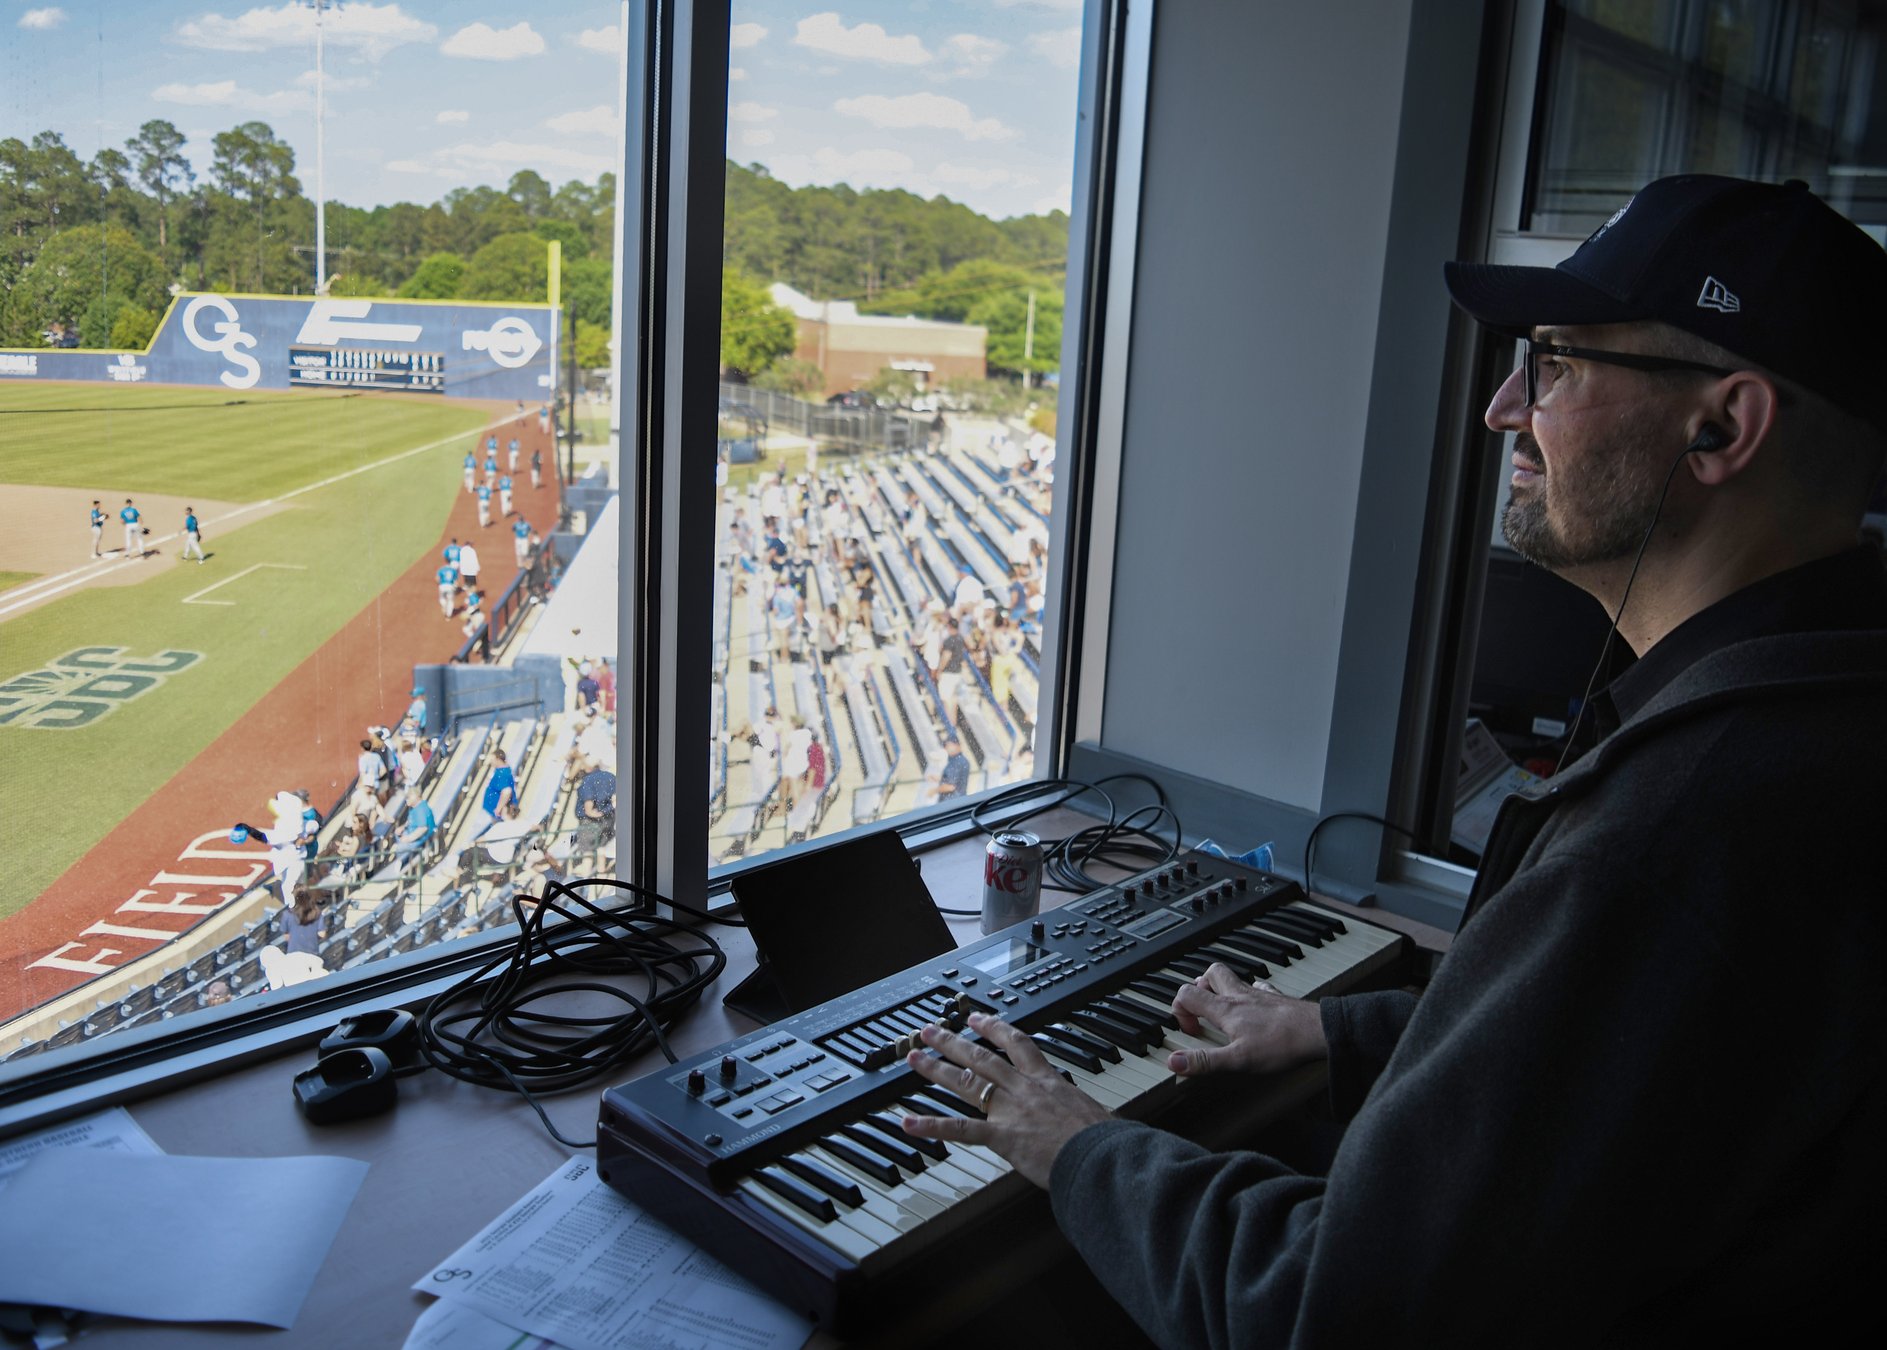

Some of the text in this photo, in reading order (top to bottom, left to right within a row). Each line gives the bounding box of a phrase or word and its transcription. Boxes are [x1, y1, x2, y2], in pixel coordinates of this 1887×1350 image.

[984, 853, 1029, 894] ke
[24, 828, 277, 975] FIELD
[720, 1123, 781, 1154] HAMMOND
